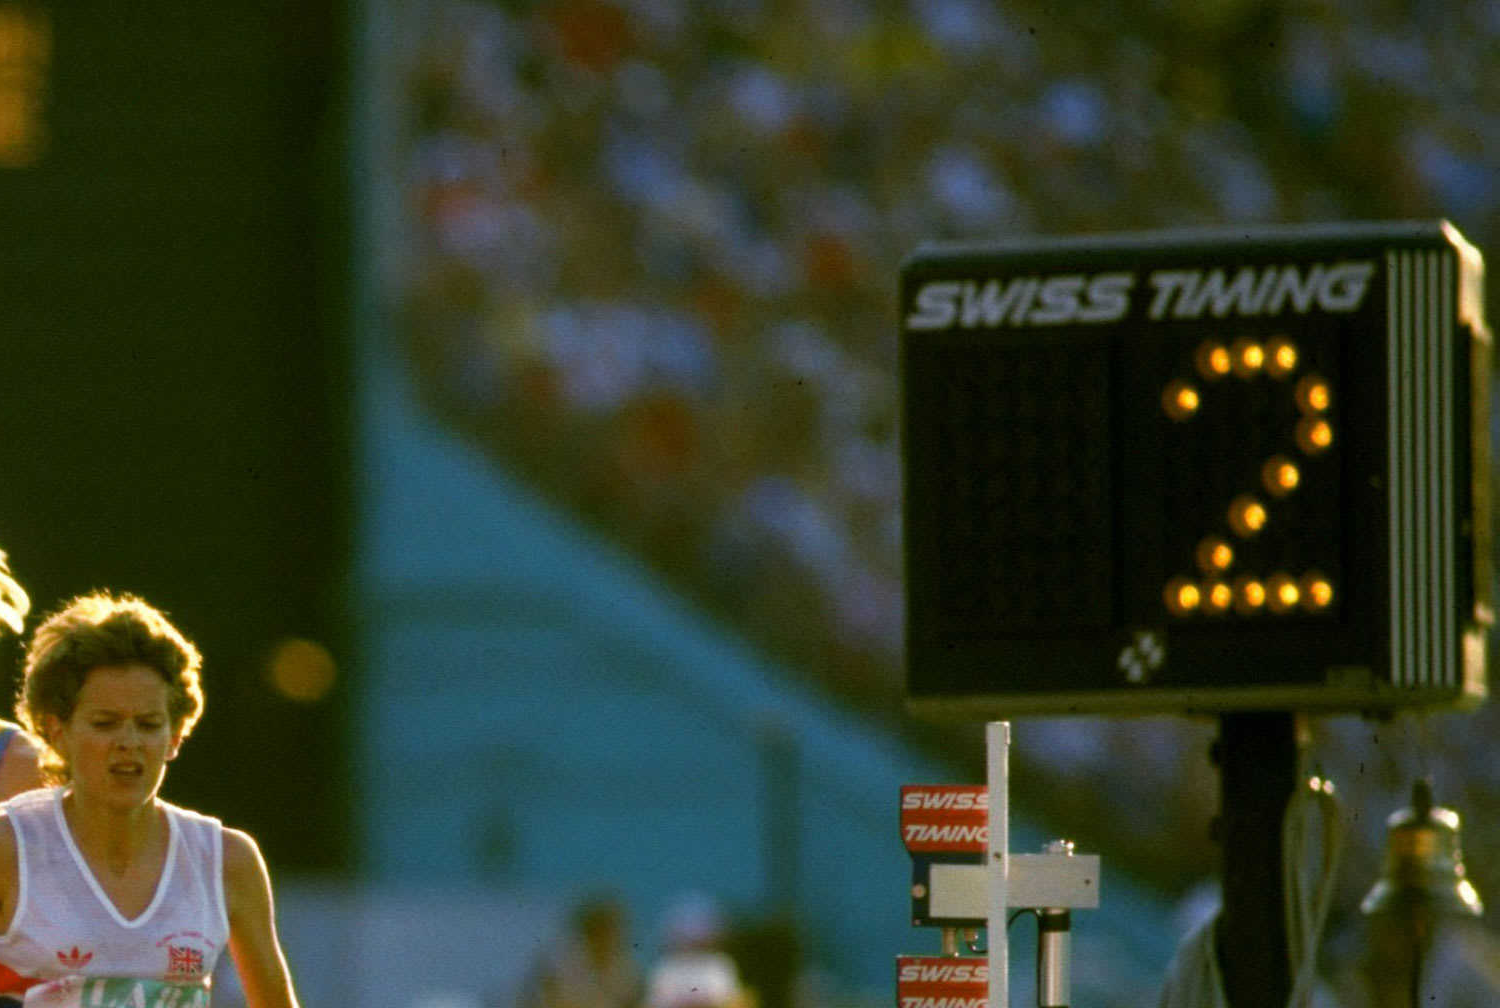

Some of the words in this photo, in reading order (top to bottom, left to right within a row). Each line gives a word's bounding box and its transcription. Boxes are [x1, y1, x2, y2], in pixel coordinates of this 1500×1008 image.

[908, 272, 1135, 331] SWISS
[1148, 261, 1376, 320] TIMING
[1175, 341, 1333, 614] 2
[901, 792, 989, 810] SWISS
[899, 965, 989, 982] SWISS
